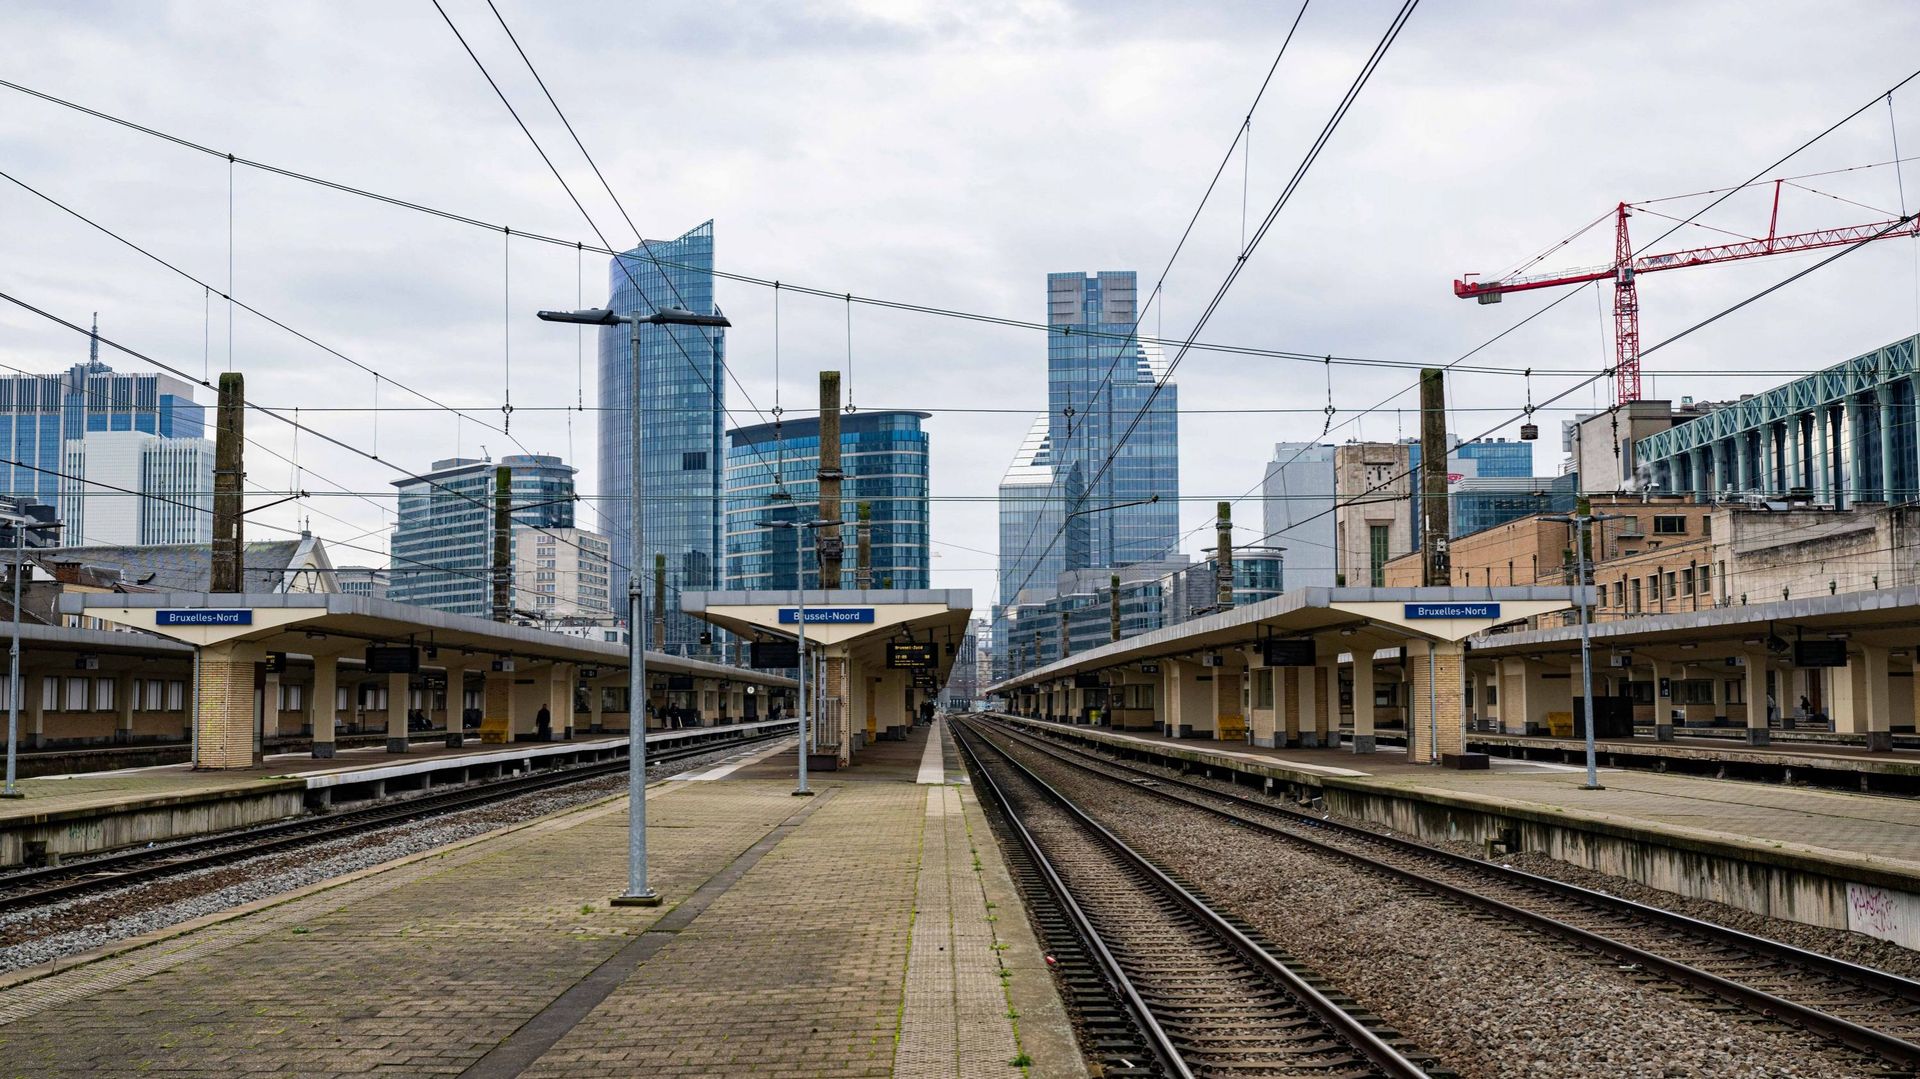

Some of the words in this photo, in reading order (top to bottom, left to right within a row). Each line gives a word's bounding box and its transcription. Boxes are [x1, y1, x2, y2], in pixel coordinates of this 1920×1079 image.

[1418, 607, 1487, 615] Bruxelles-Nord
[169, 613, 239, 621] Bruxelles-Nord
[793, 612, 860, 620] Bussel-Noord
